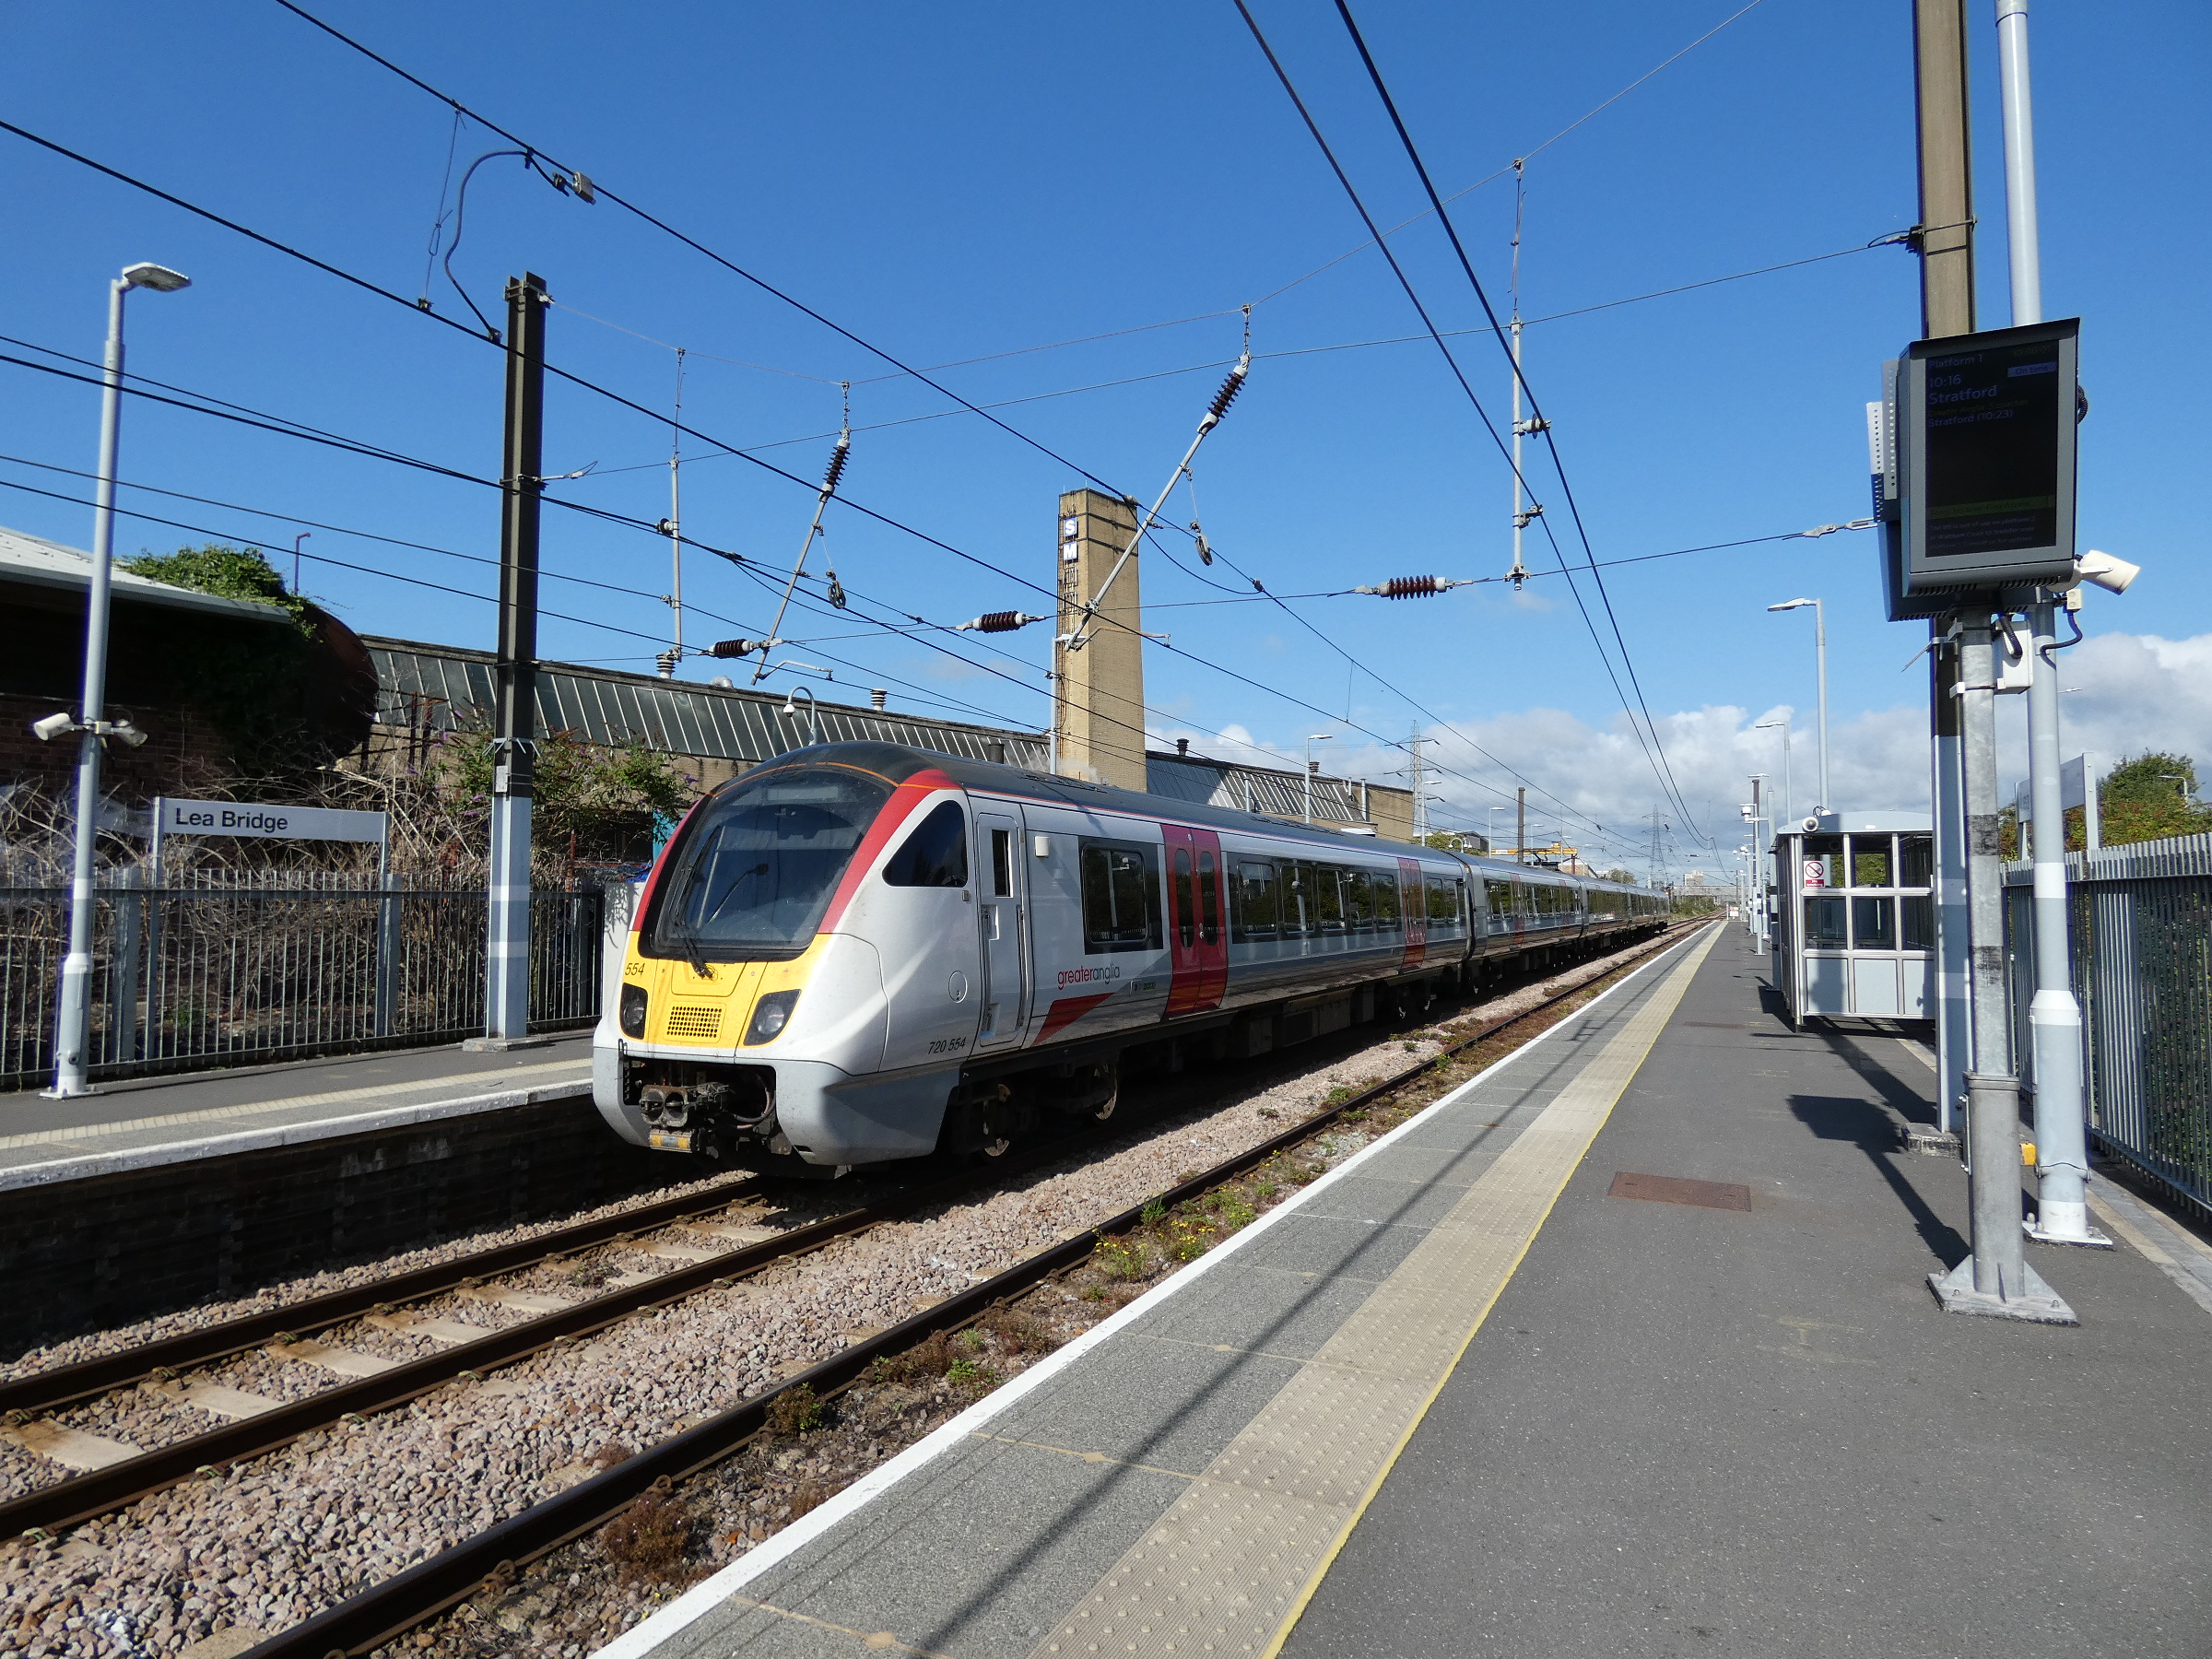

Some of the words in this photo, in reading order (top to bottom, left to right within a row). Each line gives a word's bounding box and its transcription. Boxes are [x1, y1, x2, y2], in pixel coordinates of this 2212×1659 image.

[1929, 356, 1974, 369] Platform
[1929, 374, 1961, 388] 10:16
[1928, 384, 1997, 405] Stratford
[1928, 414, 1974, 428] Stratford
[1977, 408, 2013, 421] (10:23)
[176, 807, 214, 826] Lea
[222, 810, 288, 833] Bridge
[625, 962, 645, 976] 554
[1057, 963, 1121, 990] greateranglia
[928, 1040, 947, 1054] 720
[948, 1037, 966, 1052] 554
